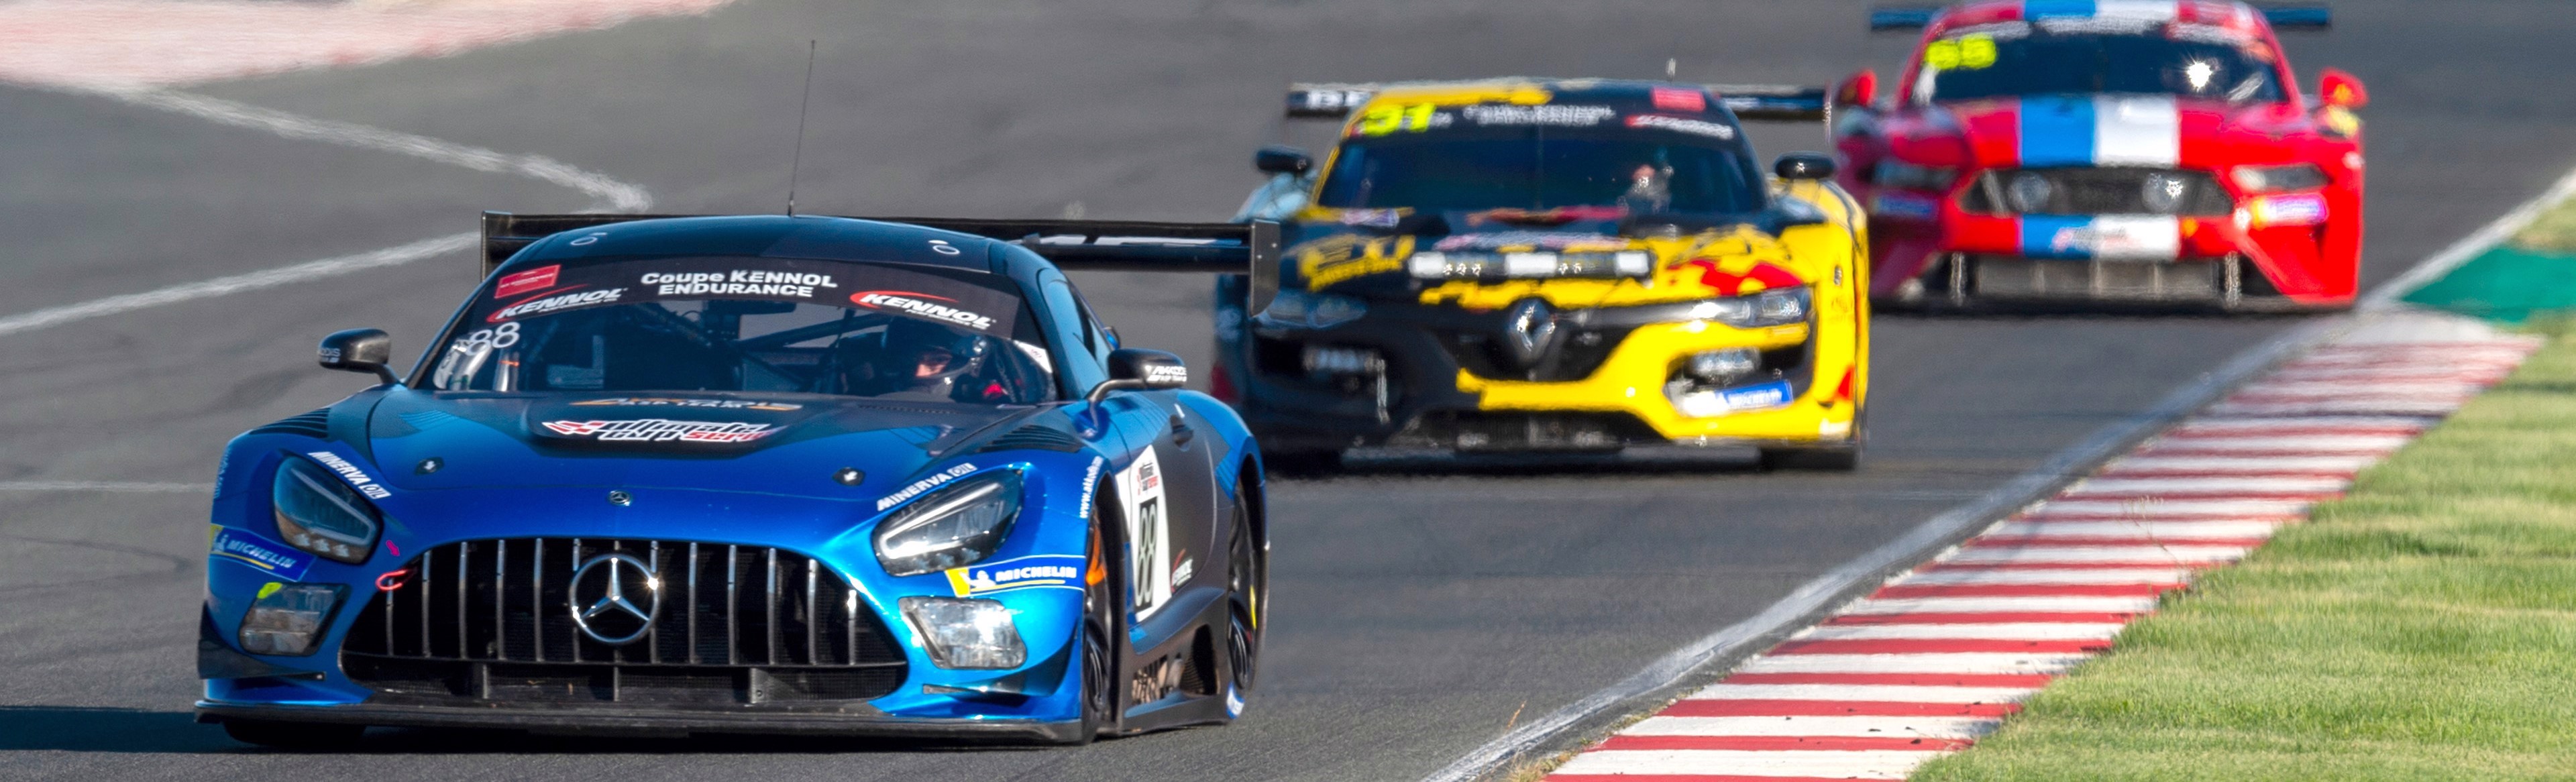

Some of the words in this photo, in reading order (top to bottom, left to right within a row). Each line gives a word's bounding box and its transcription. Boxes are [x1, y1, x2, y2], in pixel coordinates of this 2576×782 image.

[641, 272, 725, 285] Coupe
[729, 270, 838, 288] KENNOL
[657, 282, 814, 297] ENDURANCE
[495, 288, 623, 320] KENNOL
[859, 293, 991, 327] KENNOL
[465, 321, 521, 356] 88
[307, 451, 371, 485] MINERVA
[360, 484, 389, 499] OIL
[877, 473, 953, 511] MINERVA
[949, 463, 976, 476] OIL
[227, 540, 297, 568] MICHELIN
[1136, 504, 1158, 607] 88
[995, 565, 1077, 581] MICHELIN
